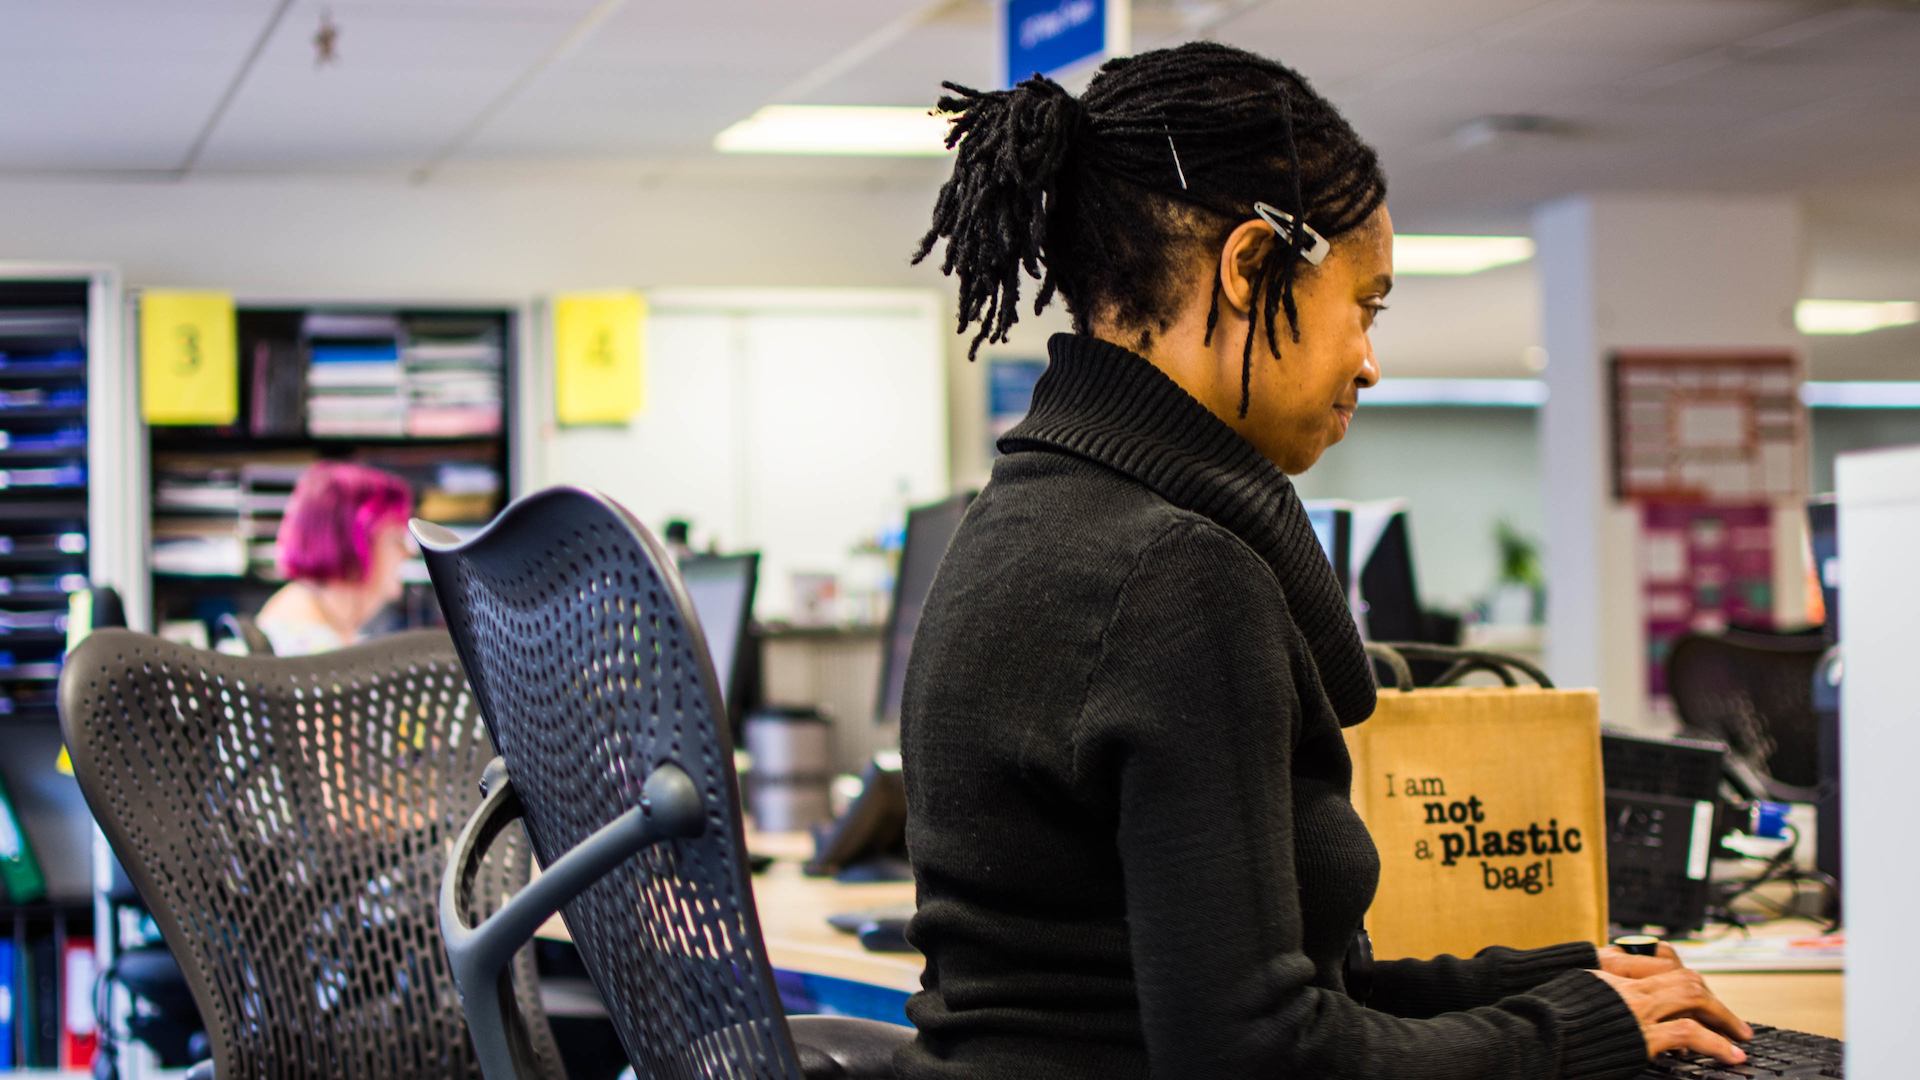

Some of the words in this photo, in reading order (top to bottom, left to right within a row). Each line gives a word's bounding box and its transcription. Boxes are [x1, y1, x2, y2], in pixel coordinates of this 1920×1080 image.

[1385, 773, 1396, 798] I
[1405, 776, 1446, 797] am
[1423, 795, 1485, 824] not
[1414, 839, 1433, 860] a
[1439, 817, 1582, 866] plastic
[1480, 859, 1554, 895] bag!
